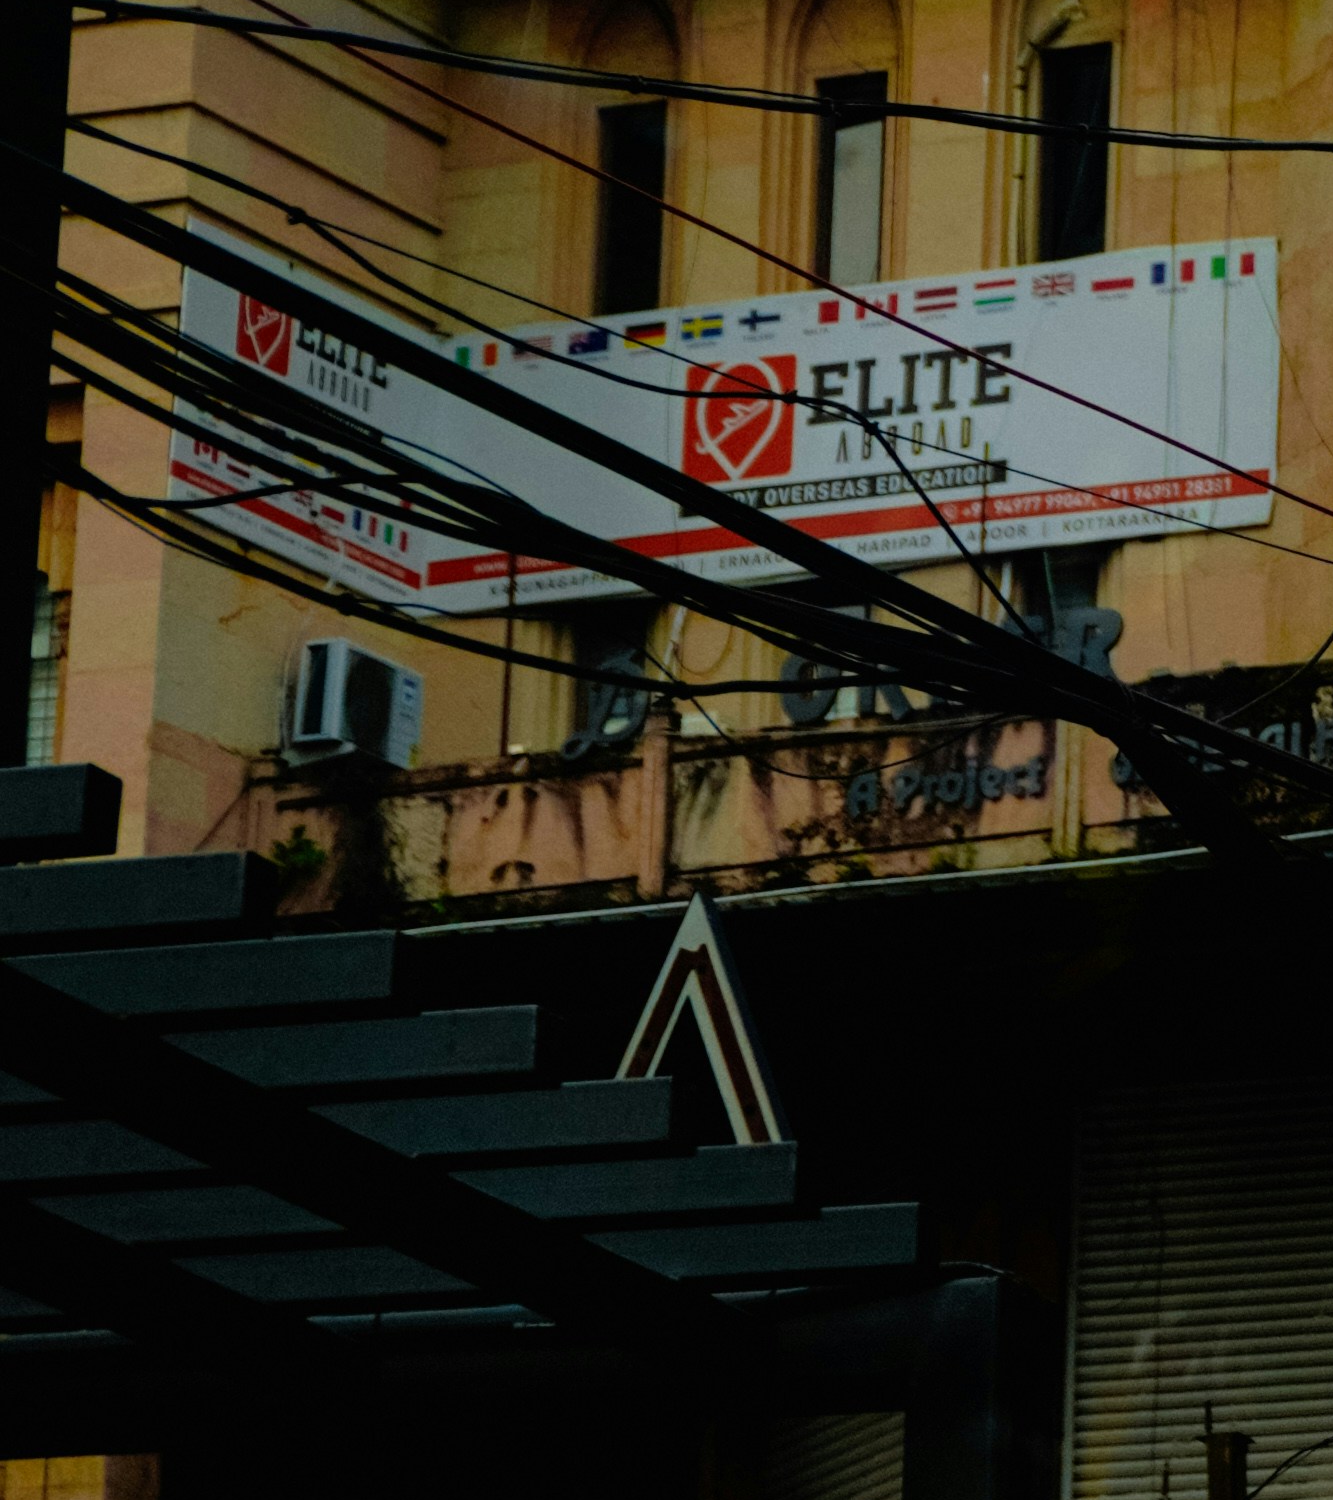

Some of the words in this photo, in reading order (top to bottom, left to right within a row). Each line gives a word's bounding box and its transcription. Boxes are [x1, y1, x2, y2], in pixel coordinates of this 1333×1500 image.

[808, 343, 1011, 425] ELITE
[763, 480, 873, 508] OVERSEAS
[857, 535, 931, 554] HARIPAD
[892, 756, 1047, 813] Project
